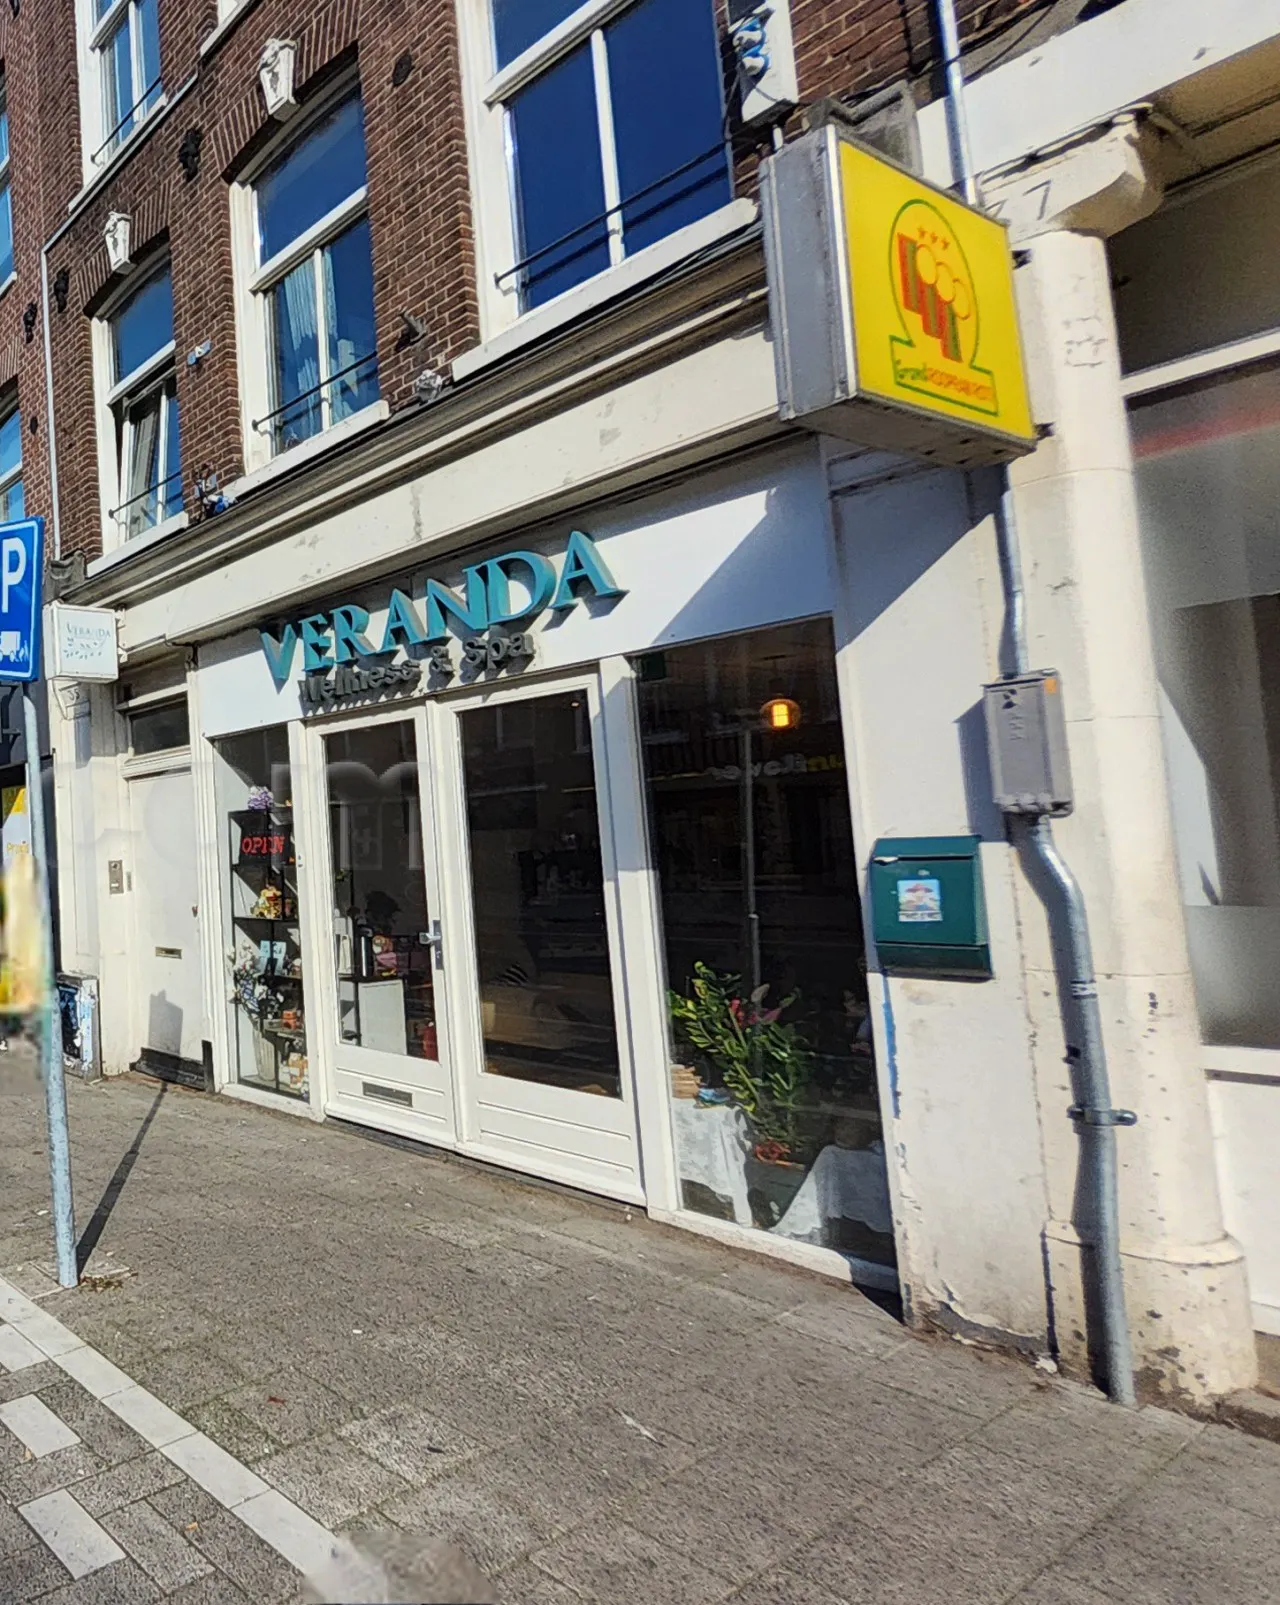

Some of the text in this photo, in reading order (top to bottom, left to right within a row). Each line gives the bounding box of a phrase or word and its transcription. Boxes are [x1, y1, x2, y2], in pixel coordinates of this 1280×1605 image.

[1, 536, 27, 614] P
[260, 530, 625, 680] VERANDA
[429, 645, 454, 672] &
[462, 631, 535, 670] spa
